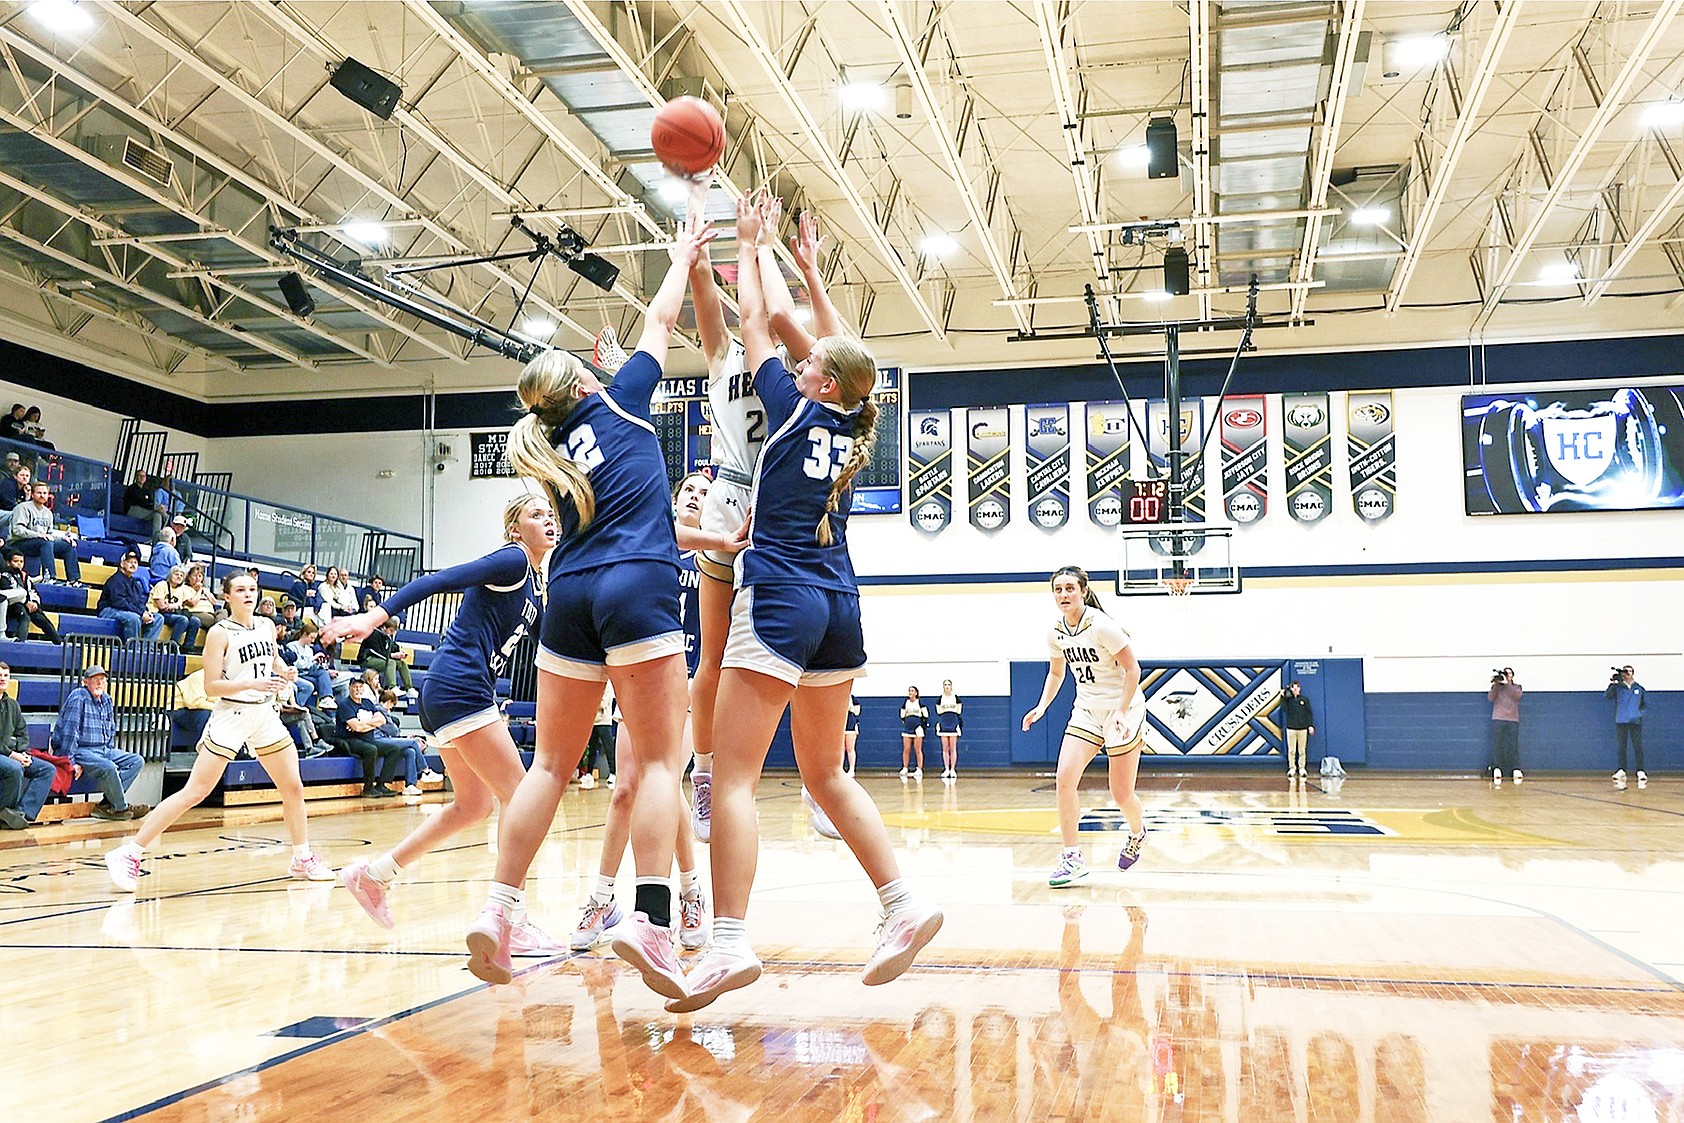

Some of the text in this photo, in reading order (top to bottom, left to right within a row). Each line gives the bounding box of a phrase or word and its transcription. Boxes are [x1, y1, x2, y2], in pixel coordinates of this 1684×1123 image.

[661, 379, 696, 396] LIAS
[729, 371, 758, 402] HE
[667, 401, 684, 413] PTS
[879, 393, 898, 404] PTS
[478, 443, 508, 454] STAT
[553, 422, 607, 474] 2
[802, 426, 856, 482] 33
[915, 440, 946, 448] SPARTANS
[1557, 431, 1603, 460] HC
[1029, 456, 1065, 484] CAPITAL CITY
[1093, 458, 1120, 480] HICKMAN
[1224, 454, 1254, 479] JEFFERSON
[1252, 446, 1266, 461] CITY
[1288, 448, 1325, 477] ROCK BRIDGE
[1350, 442, 1393, 475] SMITH-COTTON
[918, 466, 939, 484] BATTLE
[979, 468, 1006, 491] LAKERS
[1033, 464, 1068, 492] CAVALIERS
[1095, 464, 1125, 490] KEWPIES
[1236, 464, 1255, 482] JAYS
[1296, 459, 1322, 482] BRUINS
[914, 469, 948, 498] SPARTANS
[1134, 481, 1166, 498] 7:12
[976, 510, 1004, 519] CMAC
[1035, 509, 1064, 517] CMAC
[1130, 497, 1159, 521] 00
[1230, 504, 1260, 512] CMAC
[1293, 502, 1324, 510] CMAC
[1357, 500, 1388, 508] CMAC
[254, 508, 313, 531] Home Student Section
[1075, 665, 1096, 684] 24
[1208, 687, 1271, 747] CRUSADERS
